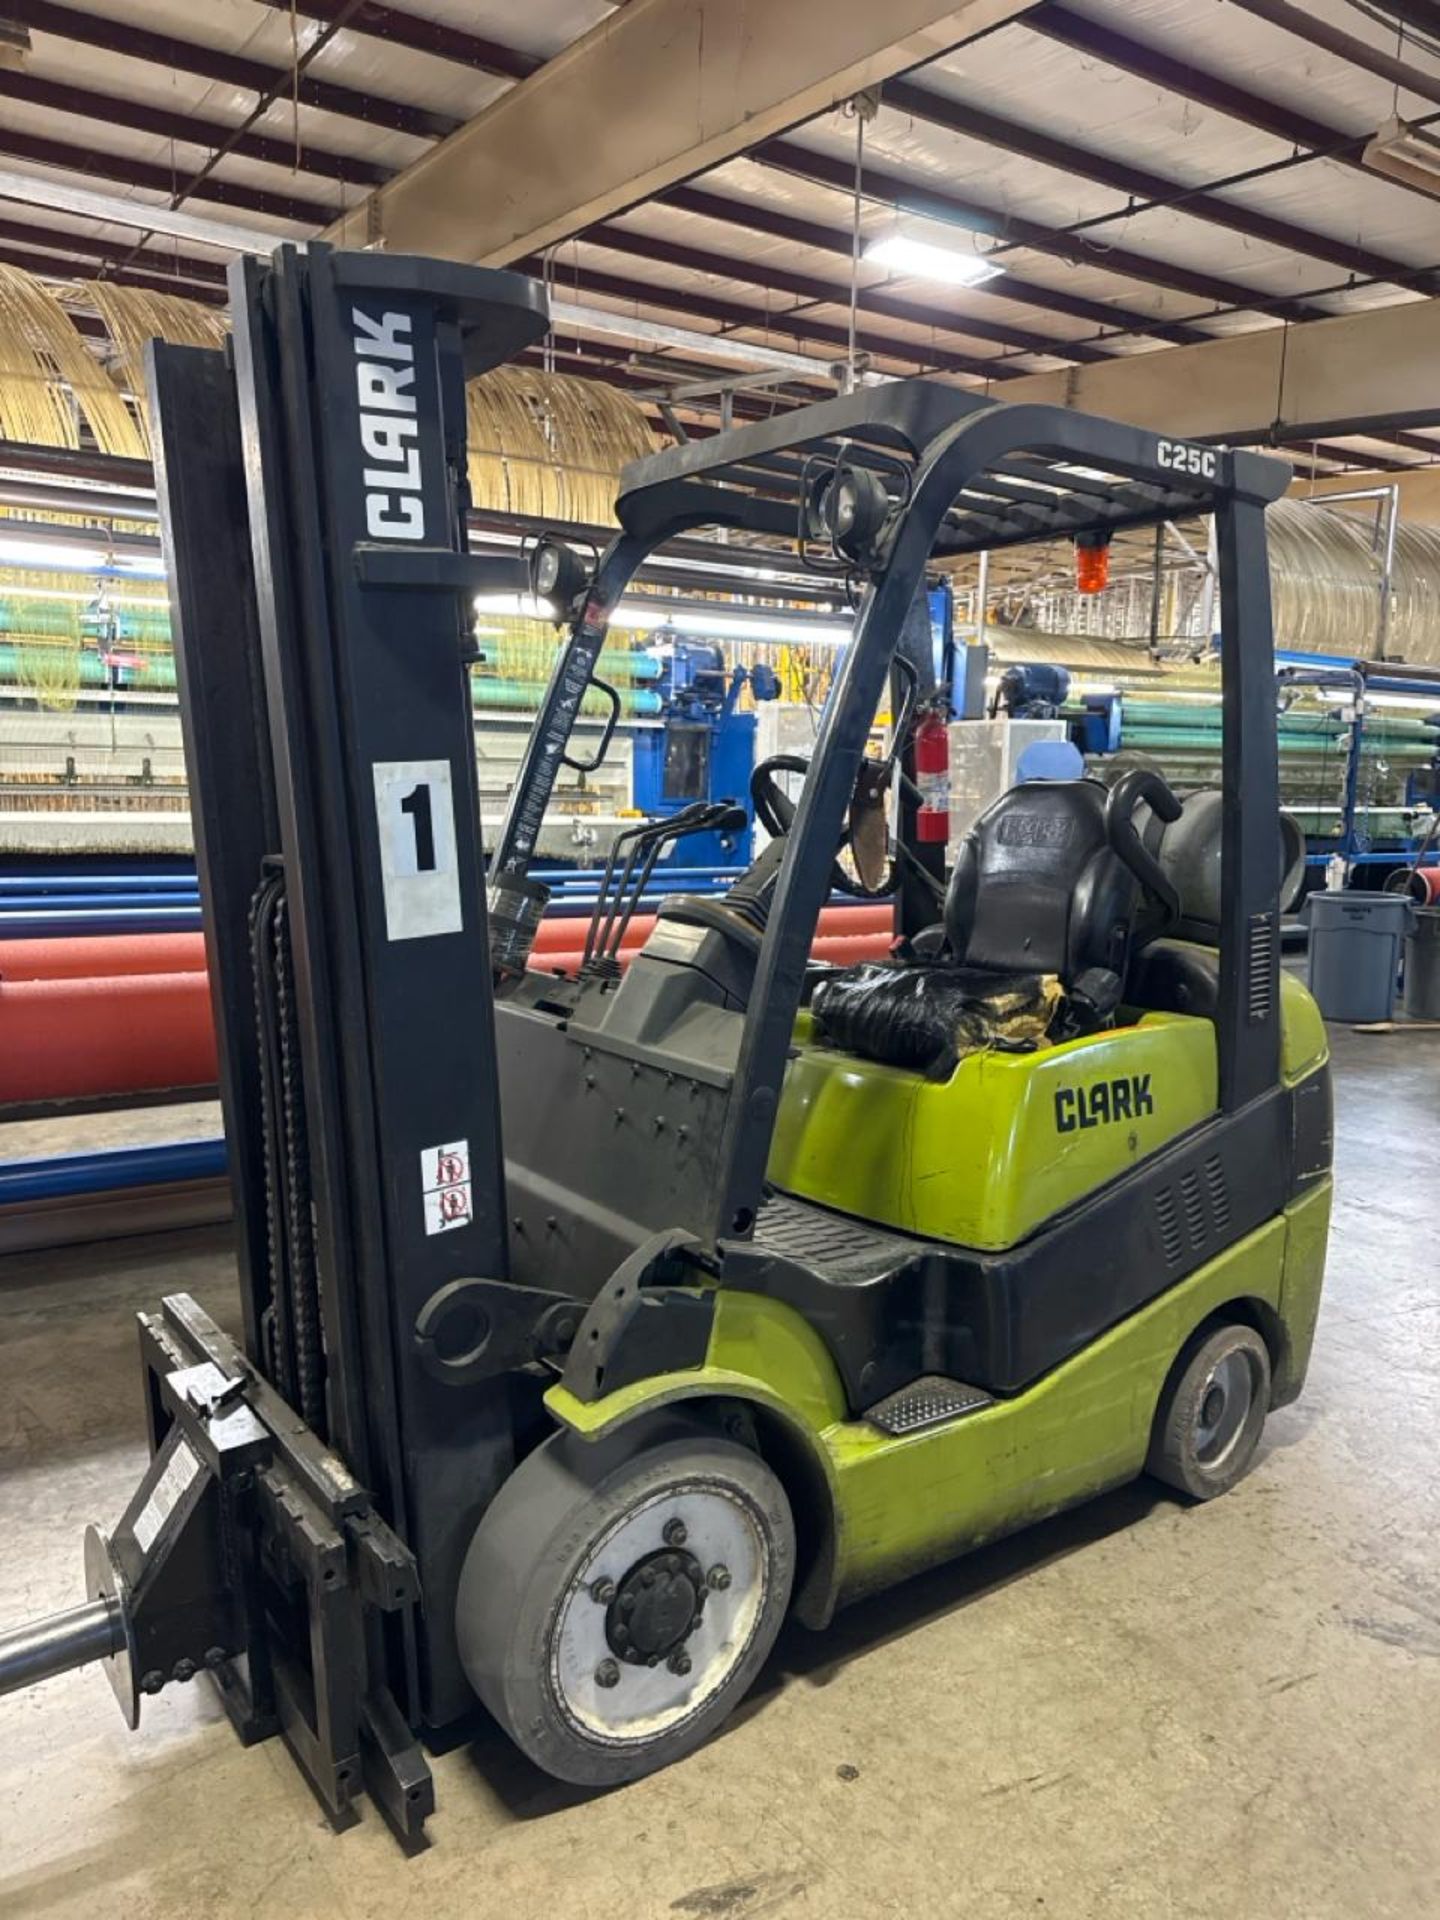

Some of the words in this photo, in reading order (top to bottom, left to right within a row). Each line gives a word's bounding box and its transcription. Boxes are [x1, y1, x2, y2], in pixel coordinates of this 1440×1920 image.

[352, 306, 425, 540] CLARK
[1157, 440, 1215, 478] C25C
[401, 783, 437, 872] 1
[1055, 1073, 1153, 1133] CLARK
